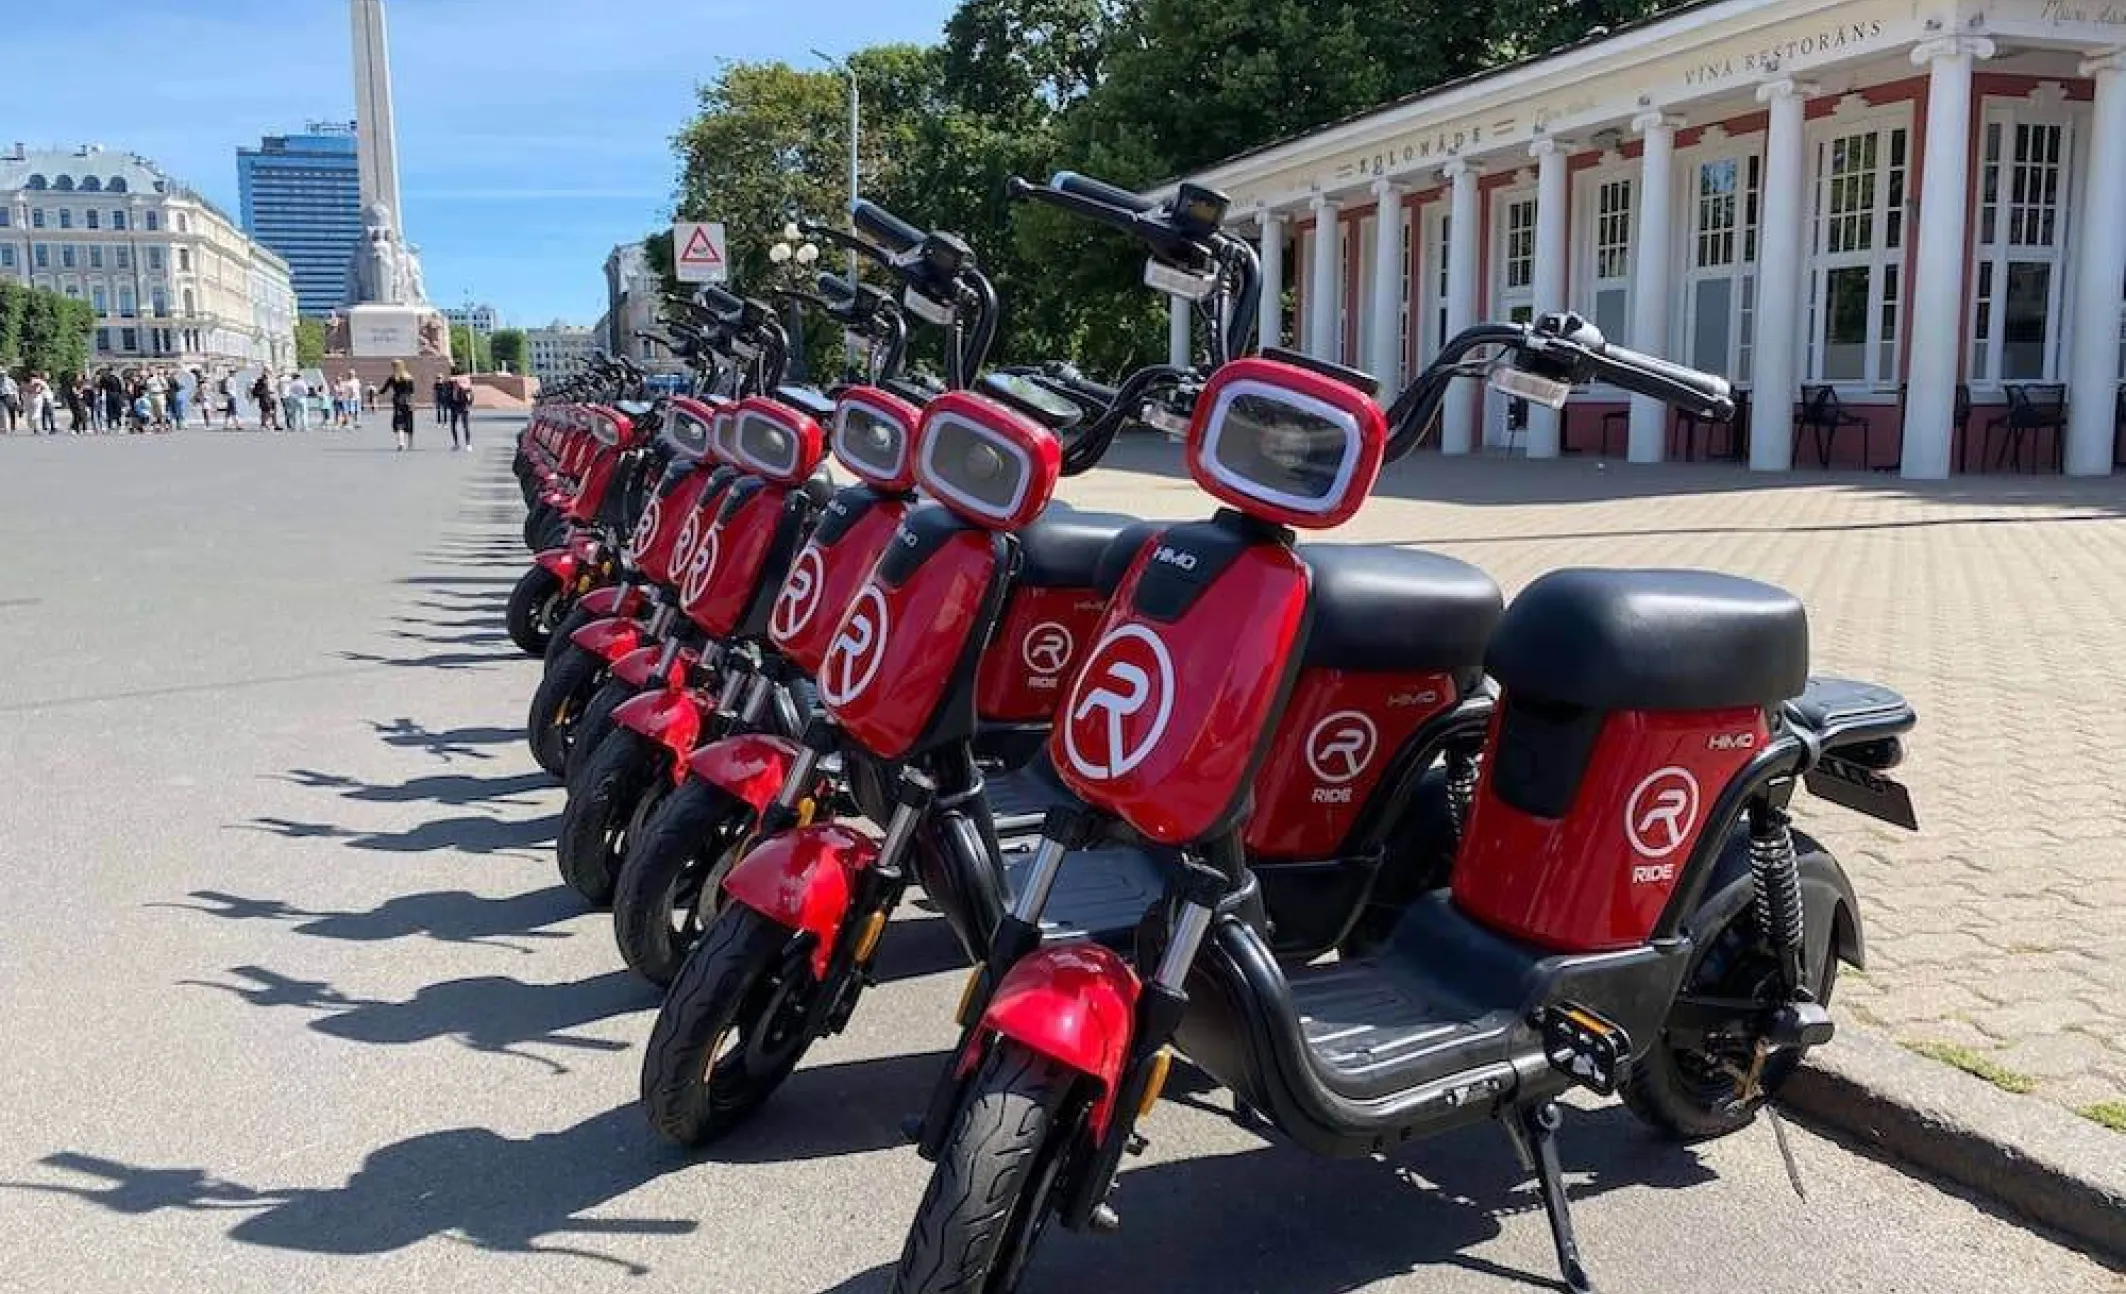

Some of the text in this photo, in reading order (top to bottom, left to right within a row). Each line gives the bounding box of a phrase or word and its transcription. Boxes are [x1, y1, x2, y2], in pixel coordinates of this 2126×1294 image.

[1708, 733, 1755, 750] HIMO
[1311, 787, 1353, 803] RIDE
[1632, 863, 1675, 884] RIDE
